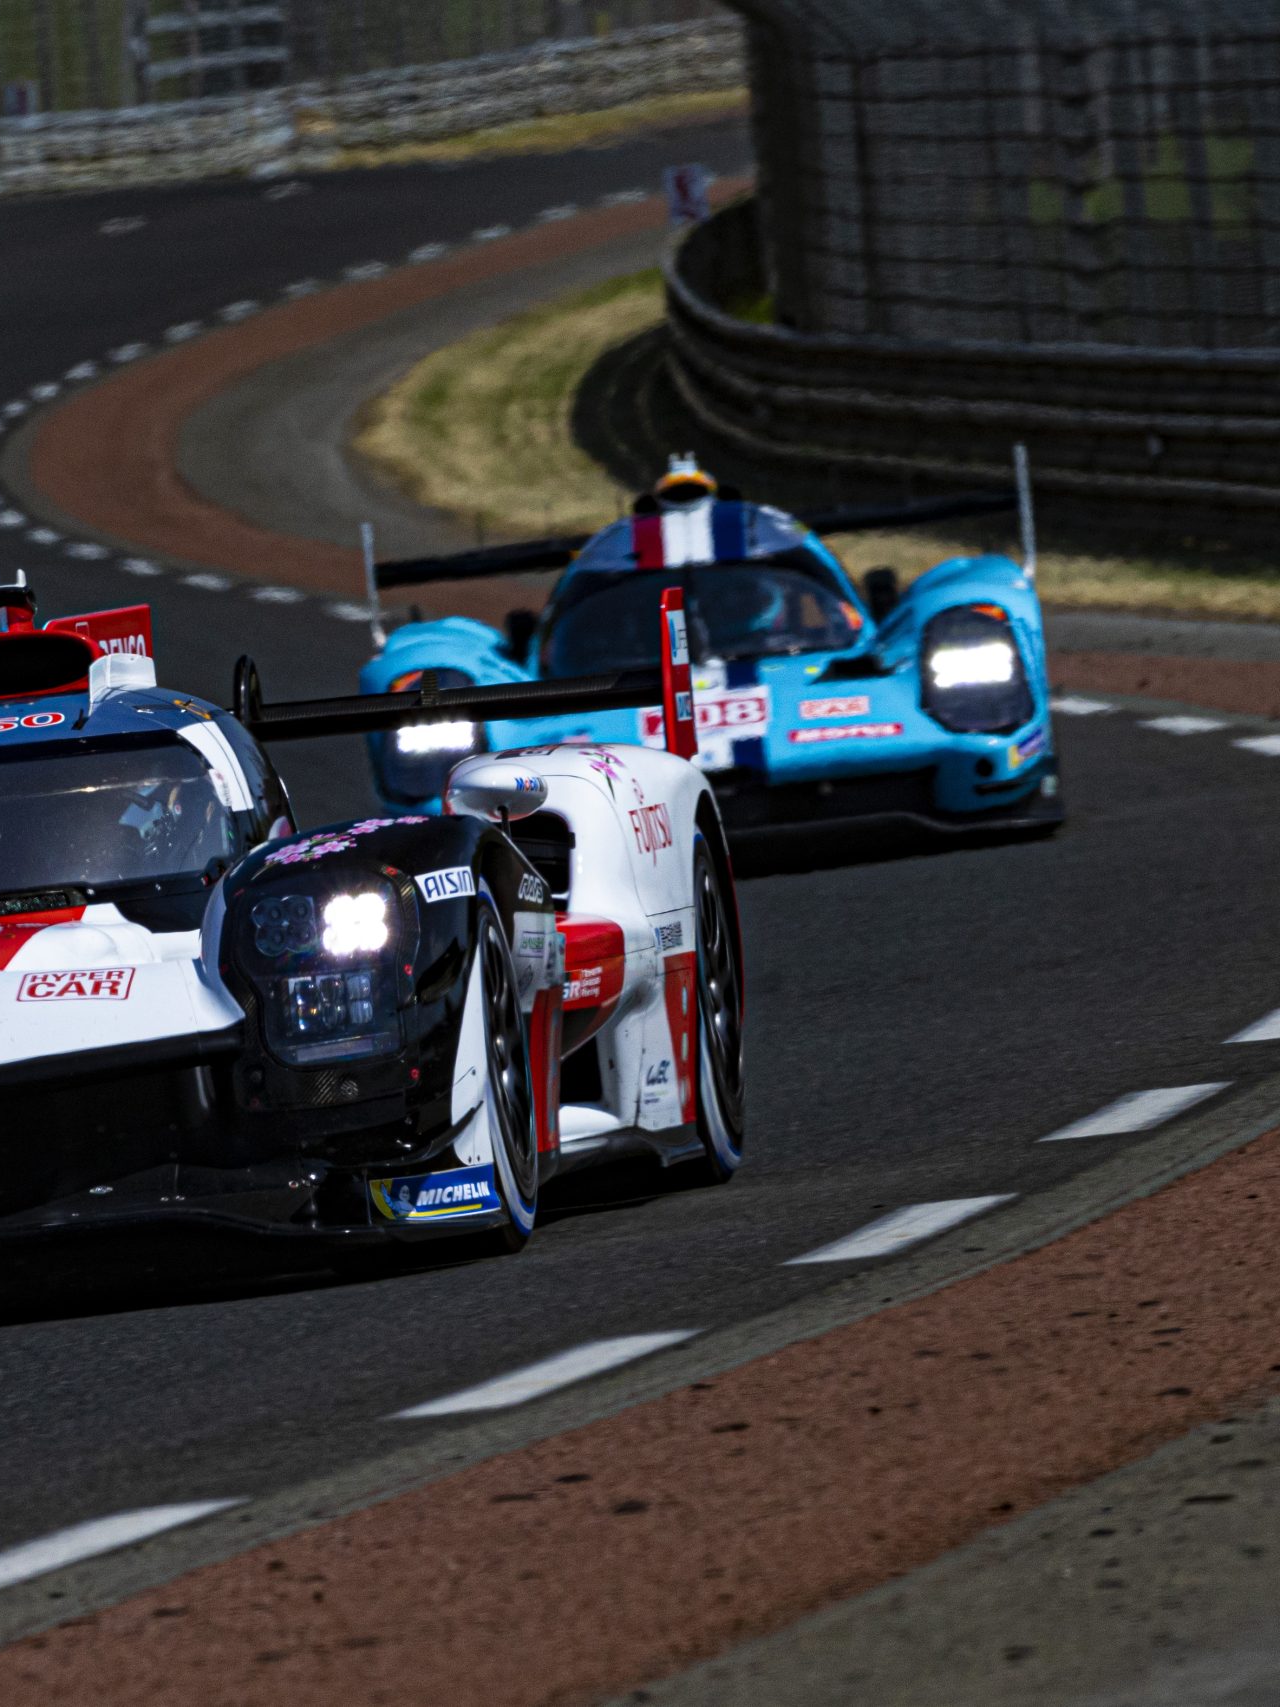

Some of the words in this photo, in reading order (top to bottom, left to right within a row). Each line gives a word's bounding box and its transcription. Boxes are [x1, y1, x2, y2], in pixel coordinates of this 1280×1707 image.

[424, 869, 475, 899] AISIN
[30, 970, 125, 982] HYPER
[26, 980, 121, 998] CAR
[416, 1180, 491, 1207] MICHELIN
